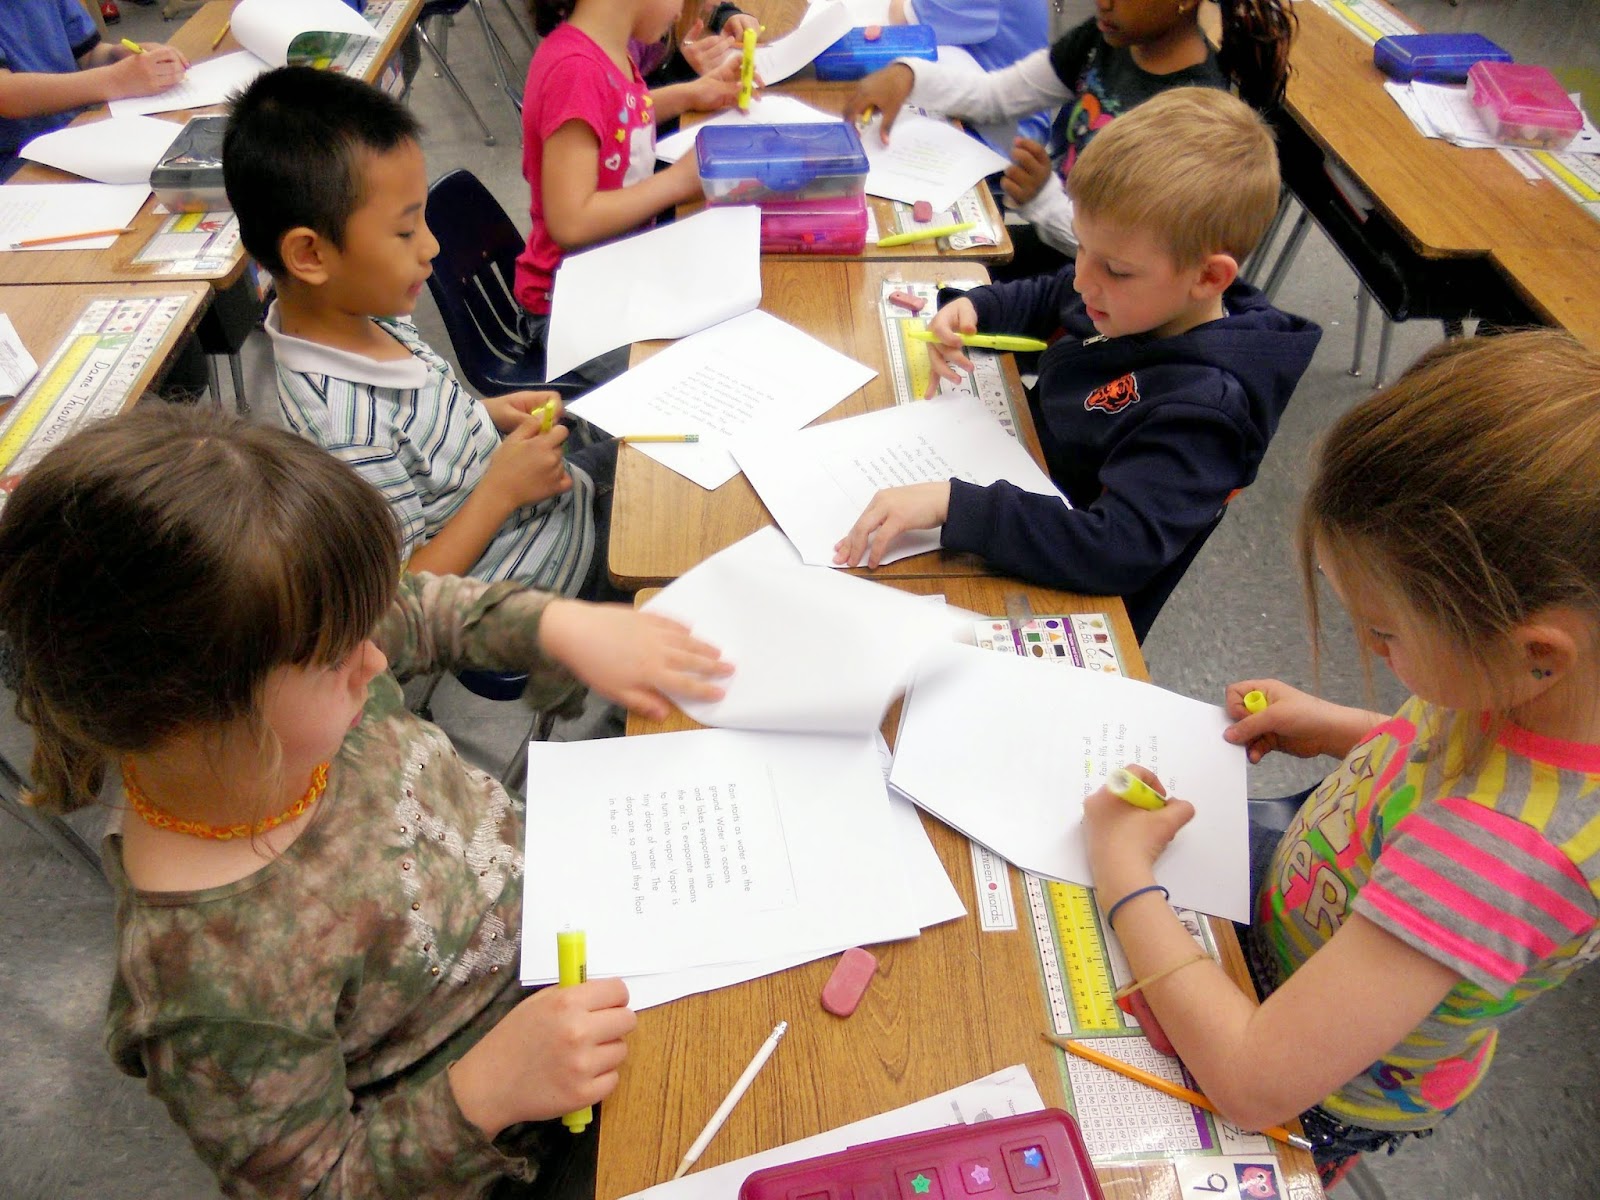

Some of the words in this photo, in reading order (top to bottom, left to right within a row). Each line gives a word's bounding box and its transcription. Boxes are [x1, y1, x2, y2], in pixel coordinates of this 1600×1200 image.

[80, 361, 110, 388] Dame
[1100, 723, 1108, 741] rivers
[1117, 724, 1126, 740] frogs
[1083, 736, 1091, 745] all
[1099, 761, 1108, 776] Rain
[1167, 776, 1176, 791] day.
[678, 790, 687, 800] the
[694, 788, 704, 801] and
[728, 784, 736, 800] Rain
[626, 796, 636, 816] drops
[642, 794, 651, 807] tiny
[610, 809, 619, 820] the
[661, 803, 669, 817] turn
[679, 805, 688, 817] air.
[697, 805, 707, 824] lakes
[731, 804, 740, 822] starts
[628, 821, 636, 833] are
[644, 811, 654, 832] drops
[664, 821, 672, 835] into
[681, 821, 690, 830] To
[610, 825, 620, 838] air.
[734, 827, 741, 835] as
[630, 838, 637, 846] so
[648, 836, 657, 844] of
[682, 835, 693, 873] evaporate
[699, 828, 712, 869] evaporates
[716, 817, 726, 840] Water
[721, 857, 731, 884] oceans
[737, 839, 746, 860] water
[631, 851, 641, 870] small
[740, 865, 749, 874] on
[632, 875, 642, 891] they
[652, 878, 661, 891] The
[667, 869, 678, 893] Vapor
[706, 874, 715, 889] into
[743, 879, 752, 892] the
[980, 849, 992, 881] etween
[987, 893, 1003, 924] words.
[689, 878, 697, 903] means
[634, 896, 644, 914] float
[1222, 1123, 1239, 1141] Zz
